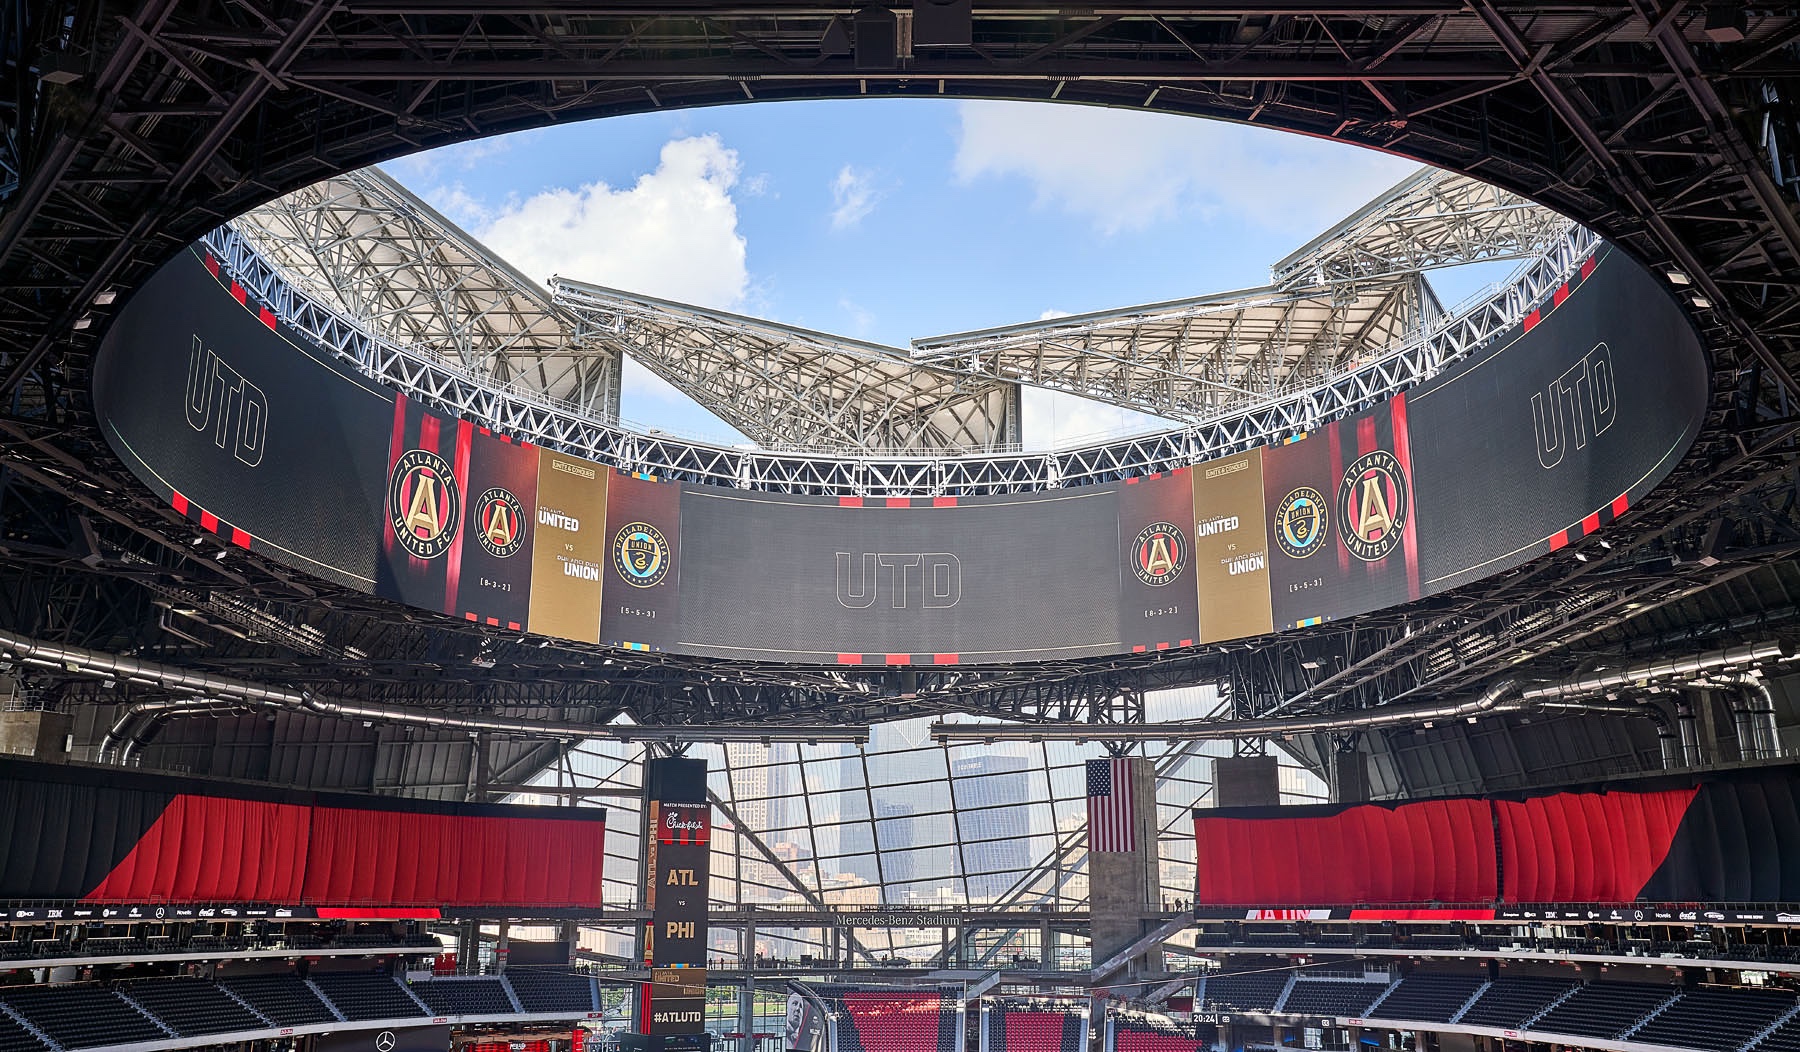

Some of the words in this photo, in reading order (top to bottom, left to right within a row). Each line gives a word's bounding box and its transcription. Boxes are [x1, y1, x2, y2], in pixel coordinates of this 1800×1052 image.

[185, 334, 268, 467] UTD
[1530, 342, 1616, 469] UTD
[403, 454, 453, 487] ATLANTA
[1345, 454, 1395, 488] ATLANTA
[407, 474, 441, 541] A
[484, 492, 519, 511] ATLANTA
[1277, 490, 1325, 526] PHILADELPHIA
[1358, 475, 1392, 542] A
[538, 510, 579, 532] UNITED
[1290, 508, 1311, 520] UNION
[395, 519, 433, 555] UNITED
[437, 531, 450, 551] FC
[1139, 525, 1178, 543] ATLANTA
[1198, 516, 1239, 537] UNITED
[479, 532, 508, 556] UNITED
[509, 541, 519, 554] FC
[565, 543, 574, 552] VS
[616, 525, 668, 557] PHILADELPHIA
[630, 540, 653, 551] UNION
[1347, 535, 1389, 556] UNITED
[1389, 519, 1403, 541] FC
[564, 562, 599, 582] UNION
[1138, 568, 1170, 585] UNITED
[1170, 563, 1183, 578] FC
[1229, 556, 1265, 576] UNION
[836, 552, 962, 609] UTD
[666, 869, 699, 887] ATL
[47, 909, 63, 918] IBM
[836, 914, 914, 926] Mercedes-Benz
[916, 915, 960, 926] Stadium
[1545, 911, 1558, 919] IBM
[666, 921, 695, 939] PHI
[653, 1012, 702, 1023] #ATLUTD
[1193, 1014, 1215, 1023] 20:24
